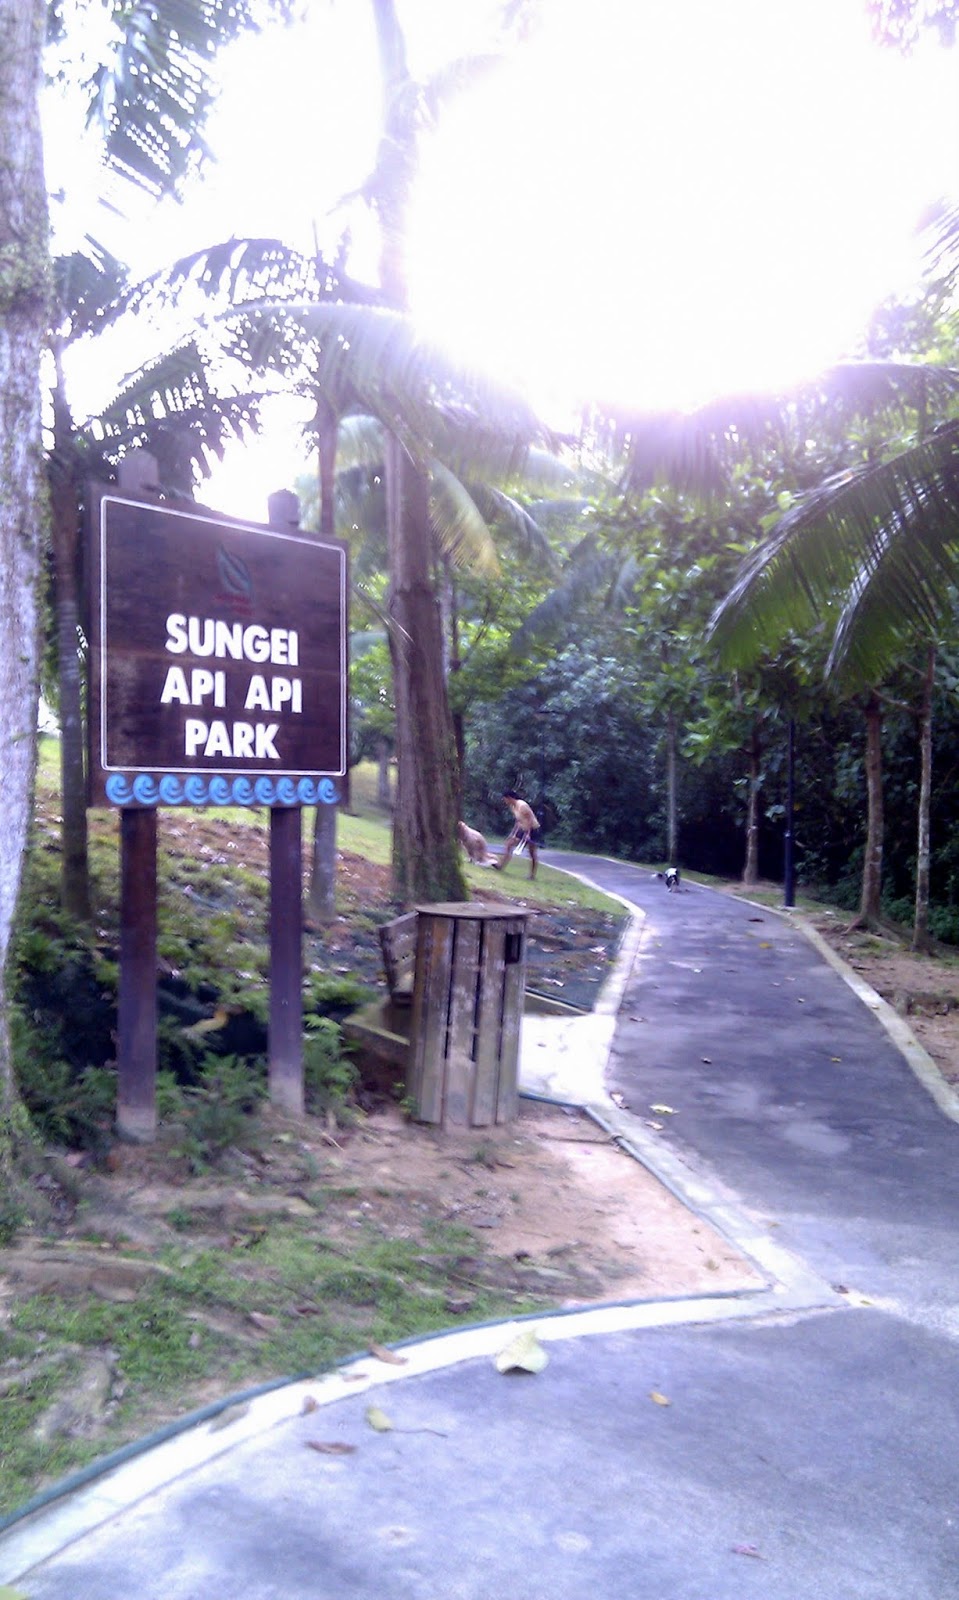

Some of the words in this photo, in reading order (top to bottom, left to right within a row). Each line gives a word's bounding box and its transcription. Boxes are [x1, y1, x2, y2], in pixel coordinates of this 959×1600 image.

[165, 614, 299, 666] SUNGEI
[160, 666, 226, 708] API
[244, 674, 303, 713] API
[185, 719, 281, 759] PARK
